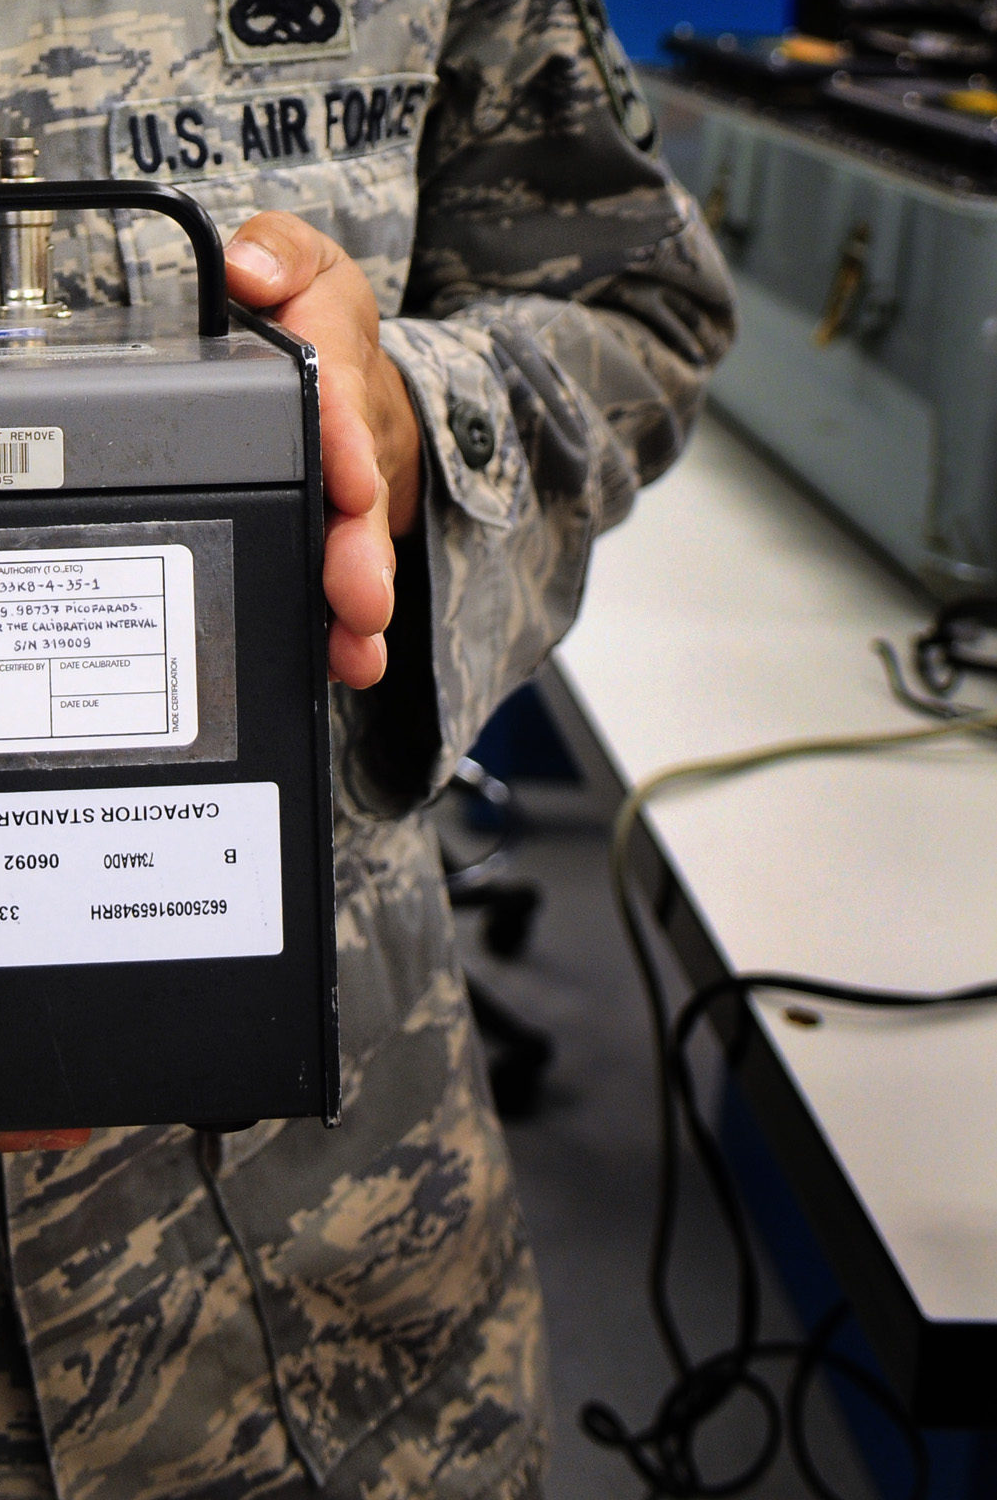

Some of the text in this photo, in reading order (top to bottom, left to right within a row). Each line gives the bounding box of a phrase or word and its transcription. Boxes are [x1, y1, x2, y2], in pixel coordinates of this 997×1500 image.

[129, 84, 425, 173] U.S. AIR FORCE
[11, 431, 55, 441] REMOVE
[0, 579, 100, 593] 33K8-4-35-1
[6, 622, 28, 631] THE
[32, 618, 103, 632] CALIBRATION
[106, 618, 158, 629] INTERVAL
[14, 639, 37, 651] S/N
[43, 637, 91, 649] 319009
[0, 663, 45, 672] CERTIFIED BY
[82, 659, 130, 669] CALIBRATED
[60, 700, 99, 708] DATE DUE
[101, 803, 219, 823] CAPACITOR
[4, 854, 59, 870] 06092
[224, 849, 237, 863] B
[91, 900, 228, 920] 6625009165948RH
